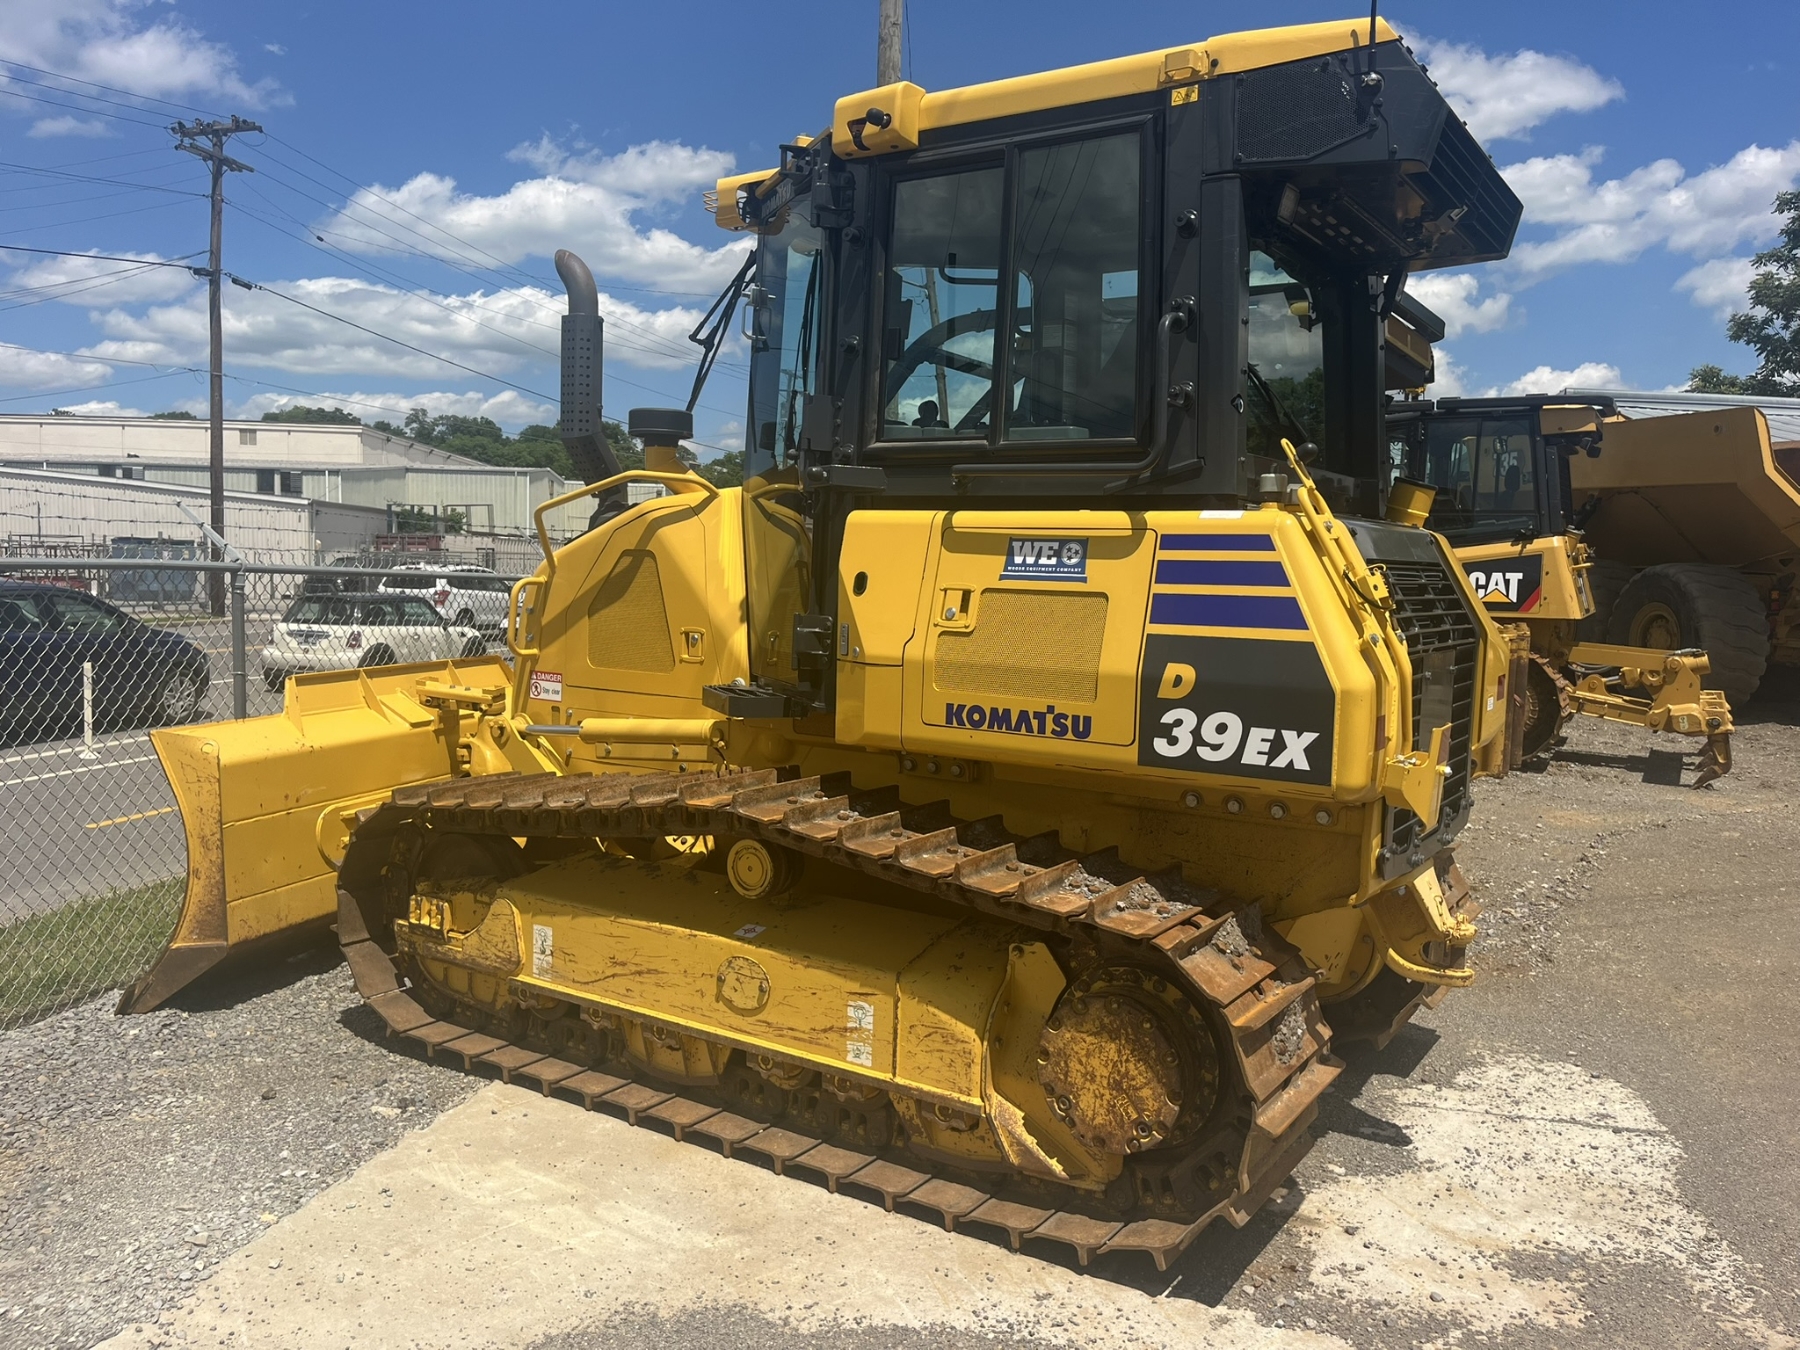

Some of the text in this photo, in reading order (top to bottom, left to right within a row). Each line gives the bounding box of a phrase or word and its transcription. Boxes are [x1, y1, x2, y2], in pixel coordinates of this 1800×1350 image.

[1012, 541, 1060, 565] WE
[1468, 571, 1523, 603] CAT
[537, 672, 562, 682] DANGER
[542, 686, 550, 696] Stay
[1157, 662, 1196, 699] D
[945, 703, 1092, 740] KOMATSU
[1153, 707, 1320, 771] 39EX
